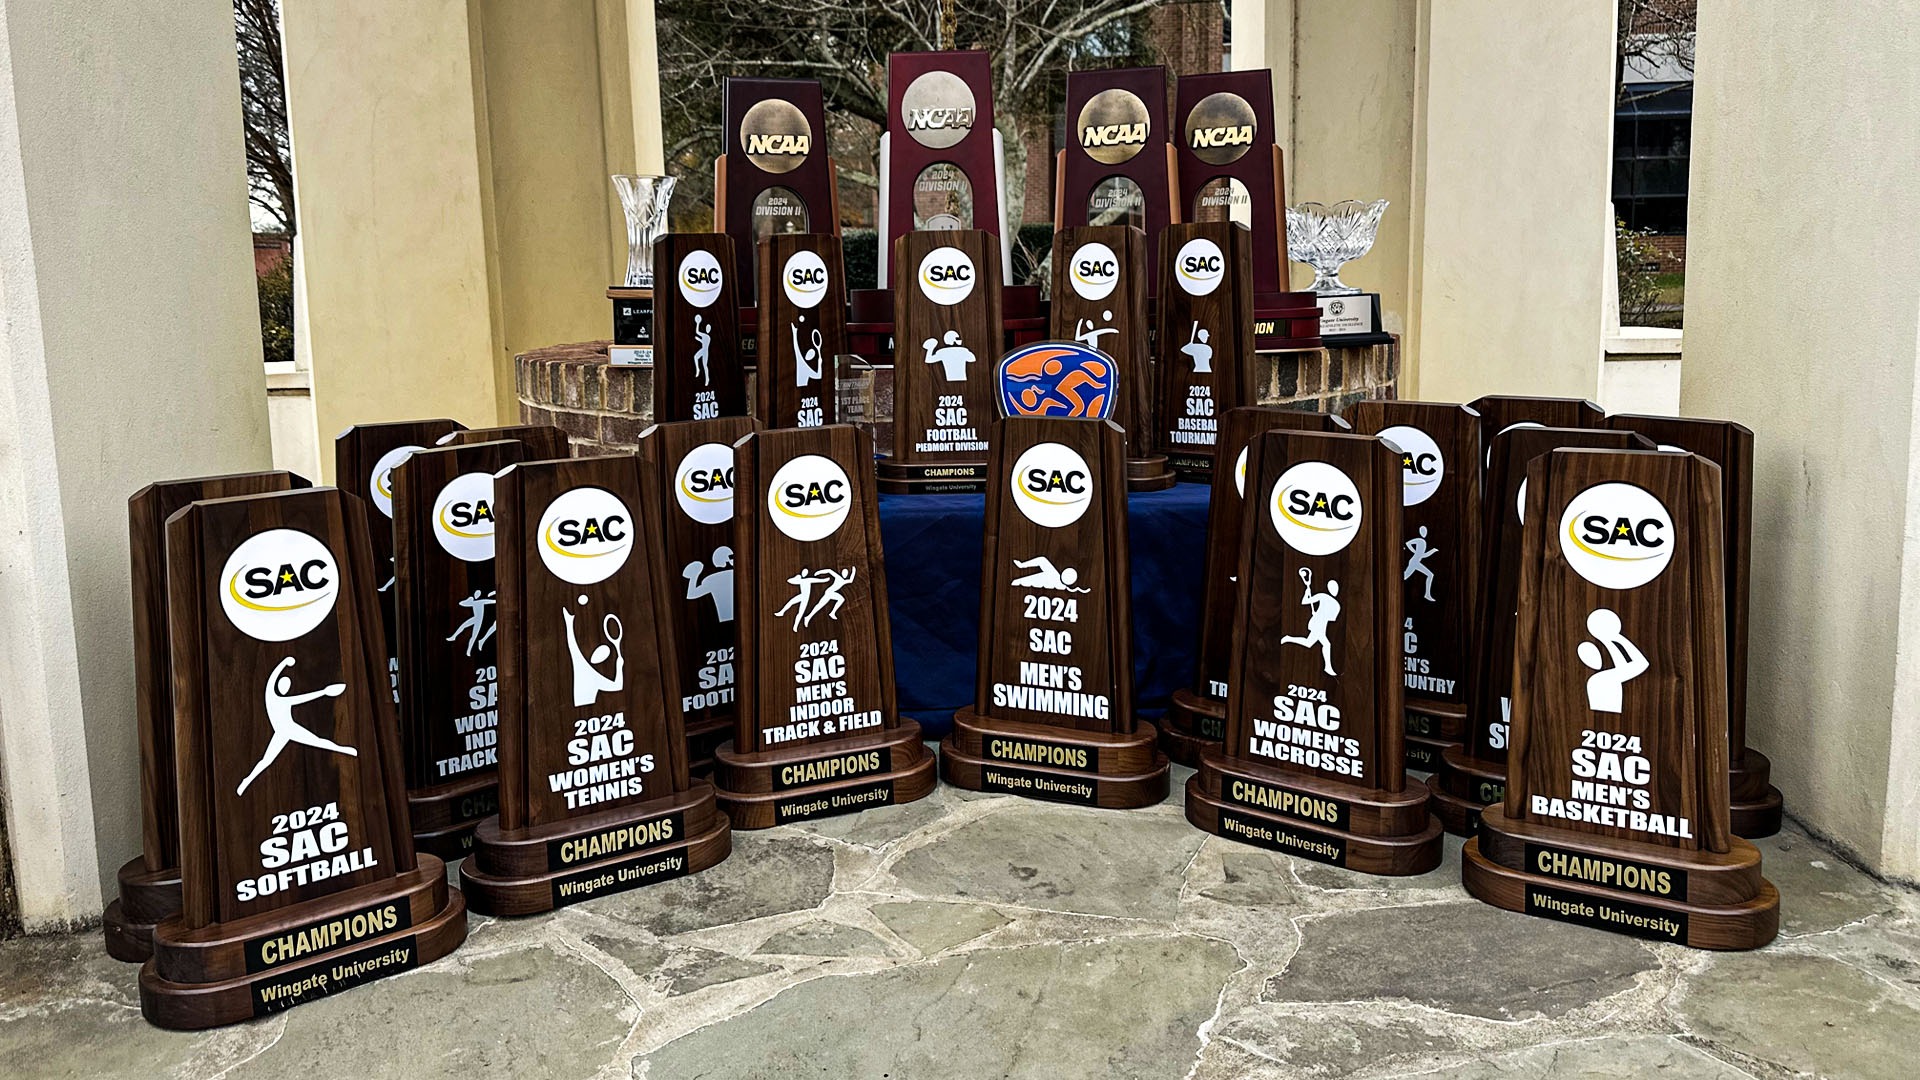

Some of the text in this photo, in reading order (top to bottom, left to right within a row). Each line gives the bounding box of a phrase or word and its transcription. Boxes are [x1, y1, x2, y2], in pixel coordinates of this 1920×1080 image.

[908, 107, 973, 130] NCAA
[748, 134, 810, 155] NCAA
[1083, 123, 1148, 147] NCAA
[1191, 126, 1253, 149] NCAA
[919, 181, 959, 191] DIVISION
[932, 171, 954, 180] 2024
[1095, 197, 1135, 208] DIVISION
[1108, 188, 1128, 197] 2024
[1202, 196, 1239, 206] DIVISION
[1214, 187, 1235, 196] 2024
[755, 206, 793, 216] DIVISION
[687, 268, 719, 285] SAC
[792, 268, 824, 285] SAC
[930, 264, 971, 282] SAC
[1079, 260, 1115, 277] SAC
[1184, 255, 1221, 274] SAC
[695, 391, 715, 403] 2024
[801, 397, 818, 408] 2024
[938, 395, 963, 407] 2024
[1189, 386, 1210, 397] 2024
[693, 401, 719, 421] SAC
[797, 408, 823, 427] SAC
[935, 408, 968, 426] SAC
[1186, 398, 1214, 416] SAC
[926, 428, 977, 441] FOOTBALL
[1178, 418, 1217, 431] BASEBA
[916, 441, 988, 452] PIEDMONT DIVISION
[1170, 431, 1217, 445] TOURNAM
[924, 468, 975, 477] CHAMPIONS
[1402, 452, 1437, 476] AC
[785, 480, 845, 507] SAC
[925, 483, 977, 492] Wingate University
[1028, 469, 1085, 494] SAC
[451, 500, 495, 527] SA
[1288, 489, 1354, 521] SAC
[558, 515, 625, 547] SAC
[1582, 515, 1664, 548] SAC
[244, 559, 329, 599] SAC
[1023, 594, 1078, 623] 2024
[799, 640, 838, 658] 2024
[1029, 628, 1072, 655] SAC
[706, 646, 734, 665] 202
[475, 666, 497, 683] 20
[699, 663, 734, 689] SA
[794, 655, 845, 684] SAC
[1020, 661, 1082, 691] MEN'S
[469, 682, 497, 710] SA
[683, 688, 734, 712] FOOT
[796, 681, 847, 703] MEN'S
[993, 683, 1109, 720] SWIMMING
[1287, 684, 1327, 702] 2024
[790, 698, 854, 722] INDOOR
[1273, 695, 1341, 731] SAC
[574, 712, 625, 736] 2024
[763, 710, 882, 744] TRACK & FIELD
[465, 729, 497, 751] IND
[567, 730, 634, 766] SAC
[1253, 718, 1360, 757] WOMEN'S
[1581, 730, 1642, 754] 2024
[436, 747, 498, 777] TRACK
[991, 739, 1087, 768] CHAMPIONS
[1250, 737, 1363, 778] LACROSSE
[548, 754, 655, 794] WOMEN'S
[781, 752, 880, 785] CHAMPIONS
[1571, 749, 1650, 785] SAC
[563, 777, 643, 810] TENNIS
[987, 772, 1092, 799] Wingate University
[1571, 780, 1650, 810] MEN'S
[781, 788, 889, 817] Wingate University
[1232, 781, 1338, 823] CHAMPIONS
[272, 802, 339, 835] 2024
[1531, 795, 1693, 839] BASKETBALL
[260, 821, 349, 869] SAC
[560, 819, 673, 863] CHAMPIONS
[1224, 817, 1340, 860] Wingate University
[236, 848, 378, 901] SOFTBALL
[559, 856, 683, 897] Wingate University
[1538, 850, 1671, 894] CHAMPIONS
[1533, 893, 1680, 937] Wingate University
[261, 905, 397, 964] CHAMPIONS
[260, 947, 410, 1003] Wingate University
